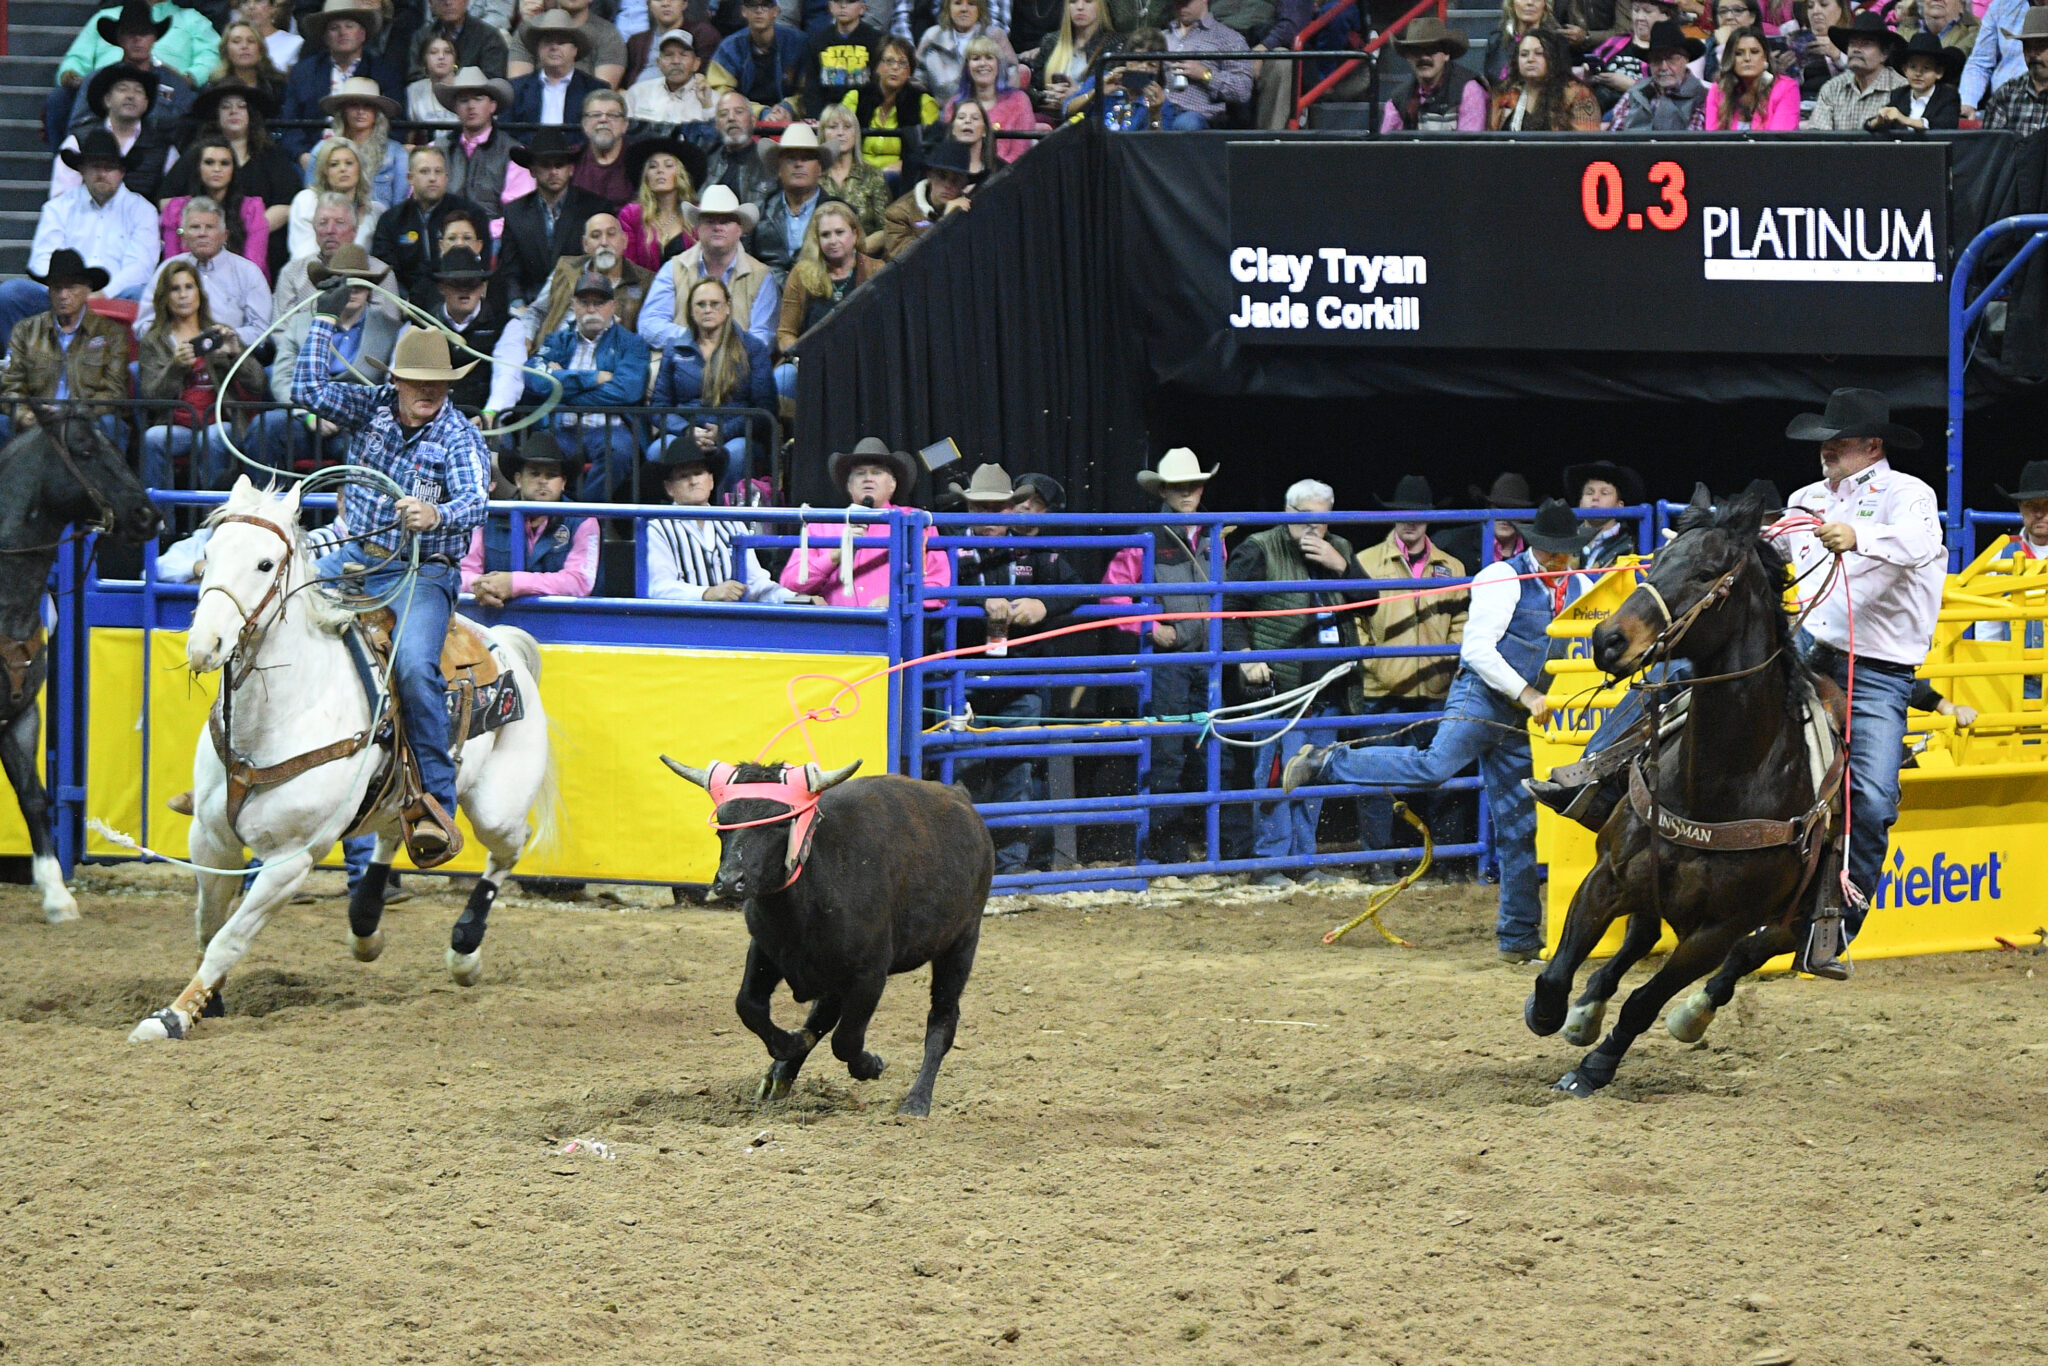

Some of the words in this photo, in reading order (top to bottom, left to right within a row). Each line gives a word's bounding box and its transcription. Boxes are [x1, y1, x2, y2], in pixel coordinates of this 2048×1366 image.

[1581, 161, 1689, 231] 0.3
[1702, 206, 1935, 260] PLATINUM
[1230, 247, 1314, 293] Clay
[1318, 248, 1427, 294] Tryan
[1229, 295, 1310, 329] Jade
[1316, 296, 1420, 331] Corkill
[1875, 845, 2002, 910] riefert
